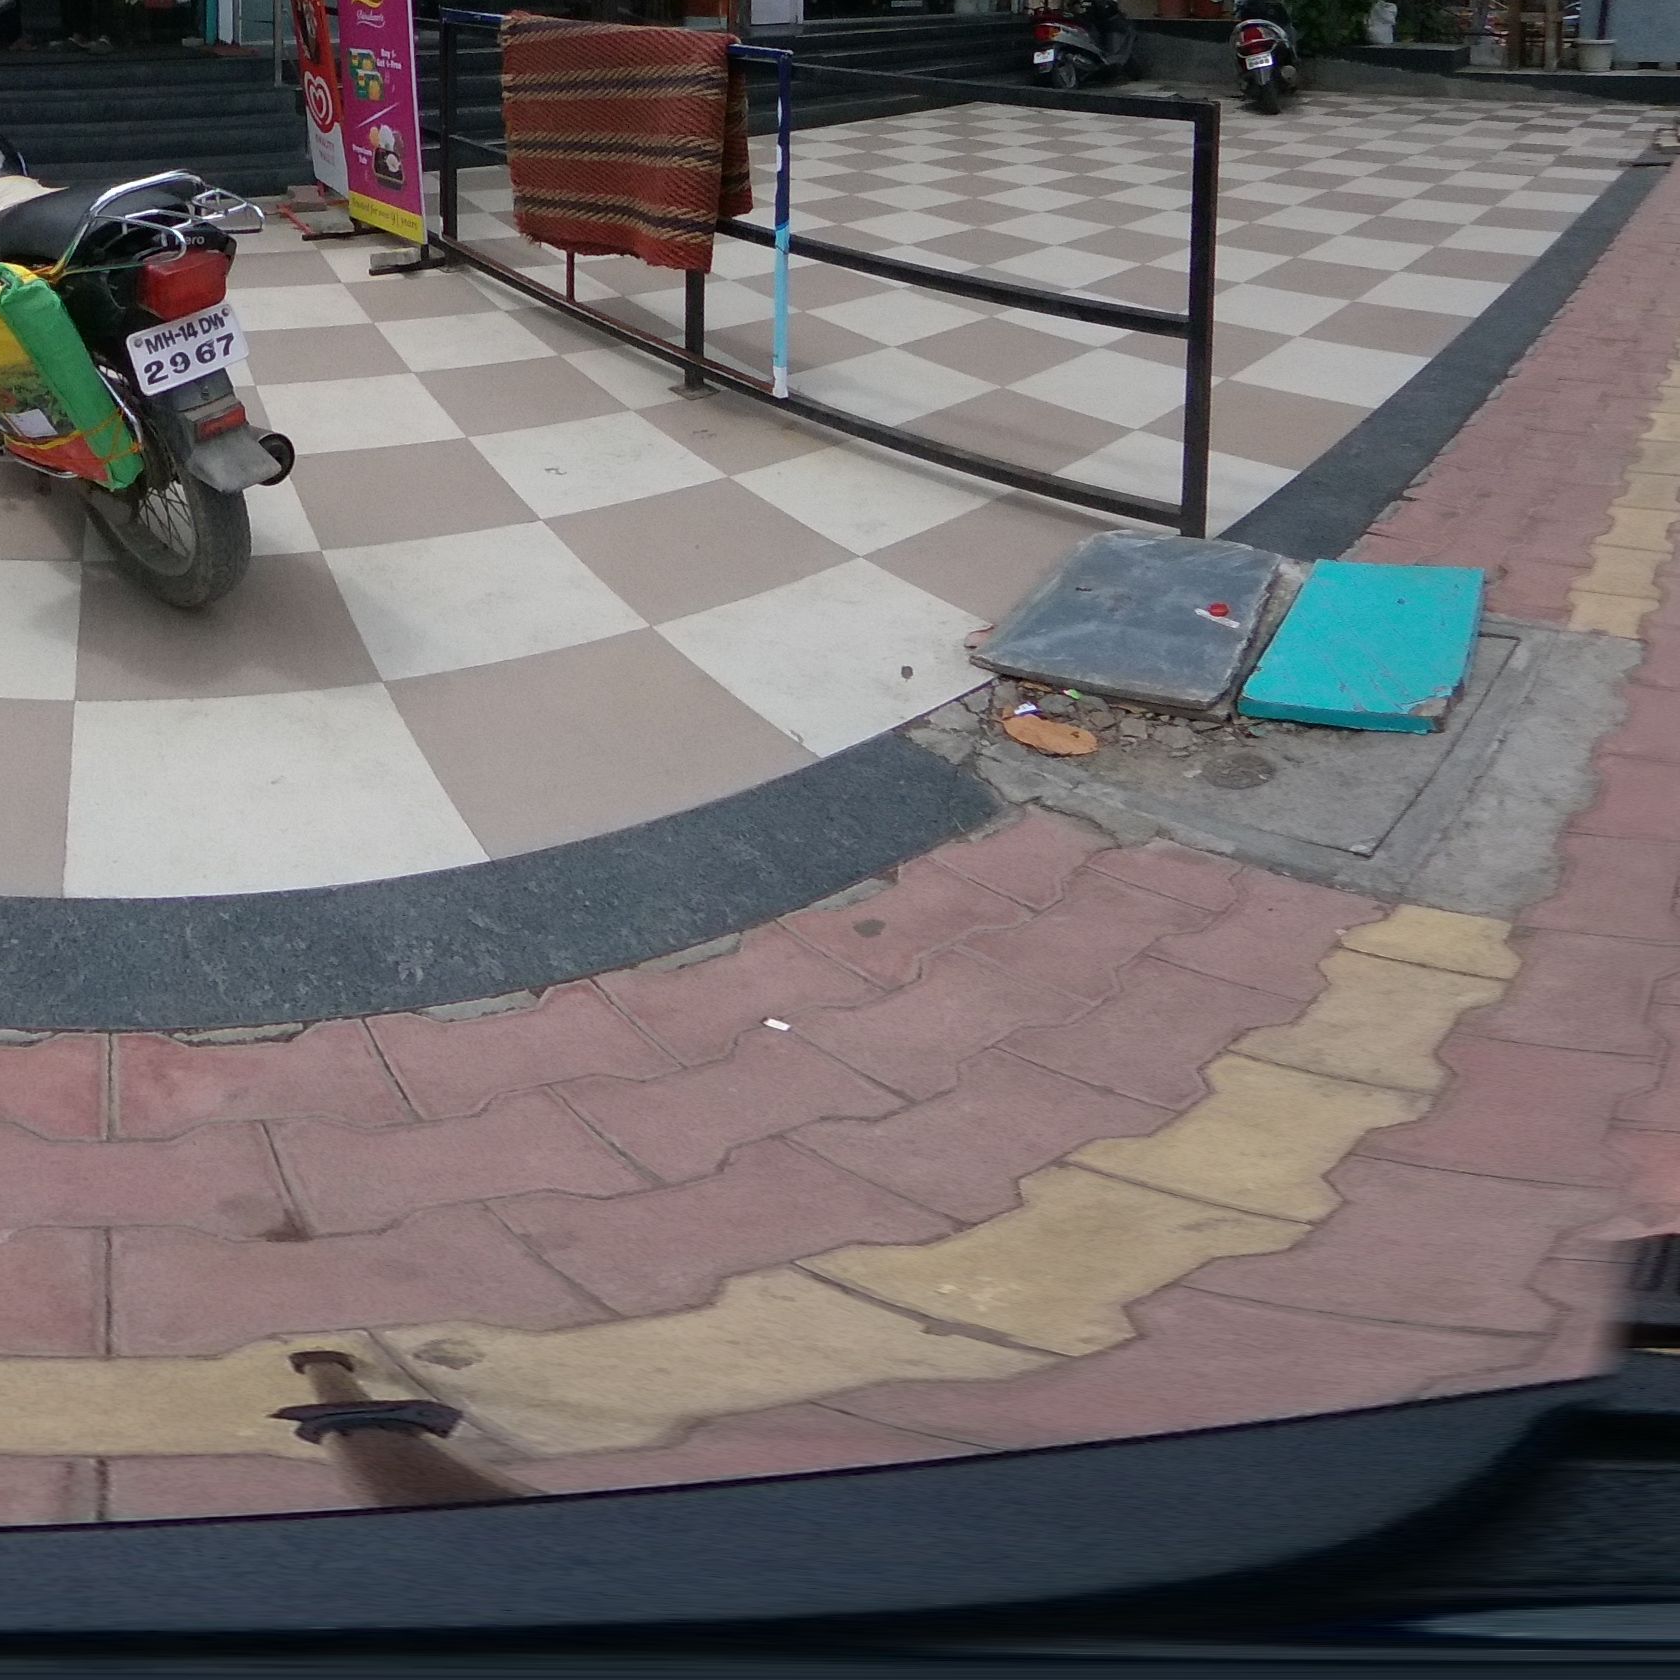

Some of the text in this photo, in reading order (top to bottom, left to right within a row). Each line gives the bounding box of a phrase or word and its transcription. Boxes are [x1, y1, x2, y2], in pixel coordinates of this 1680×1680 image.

[144, 313, 226, 355] MH-14 DW
[143, 332, 235, 386] 2967
